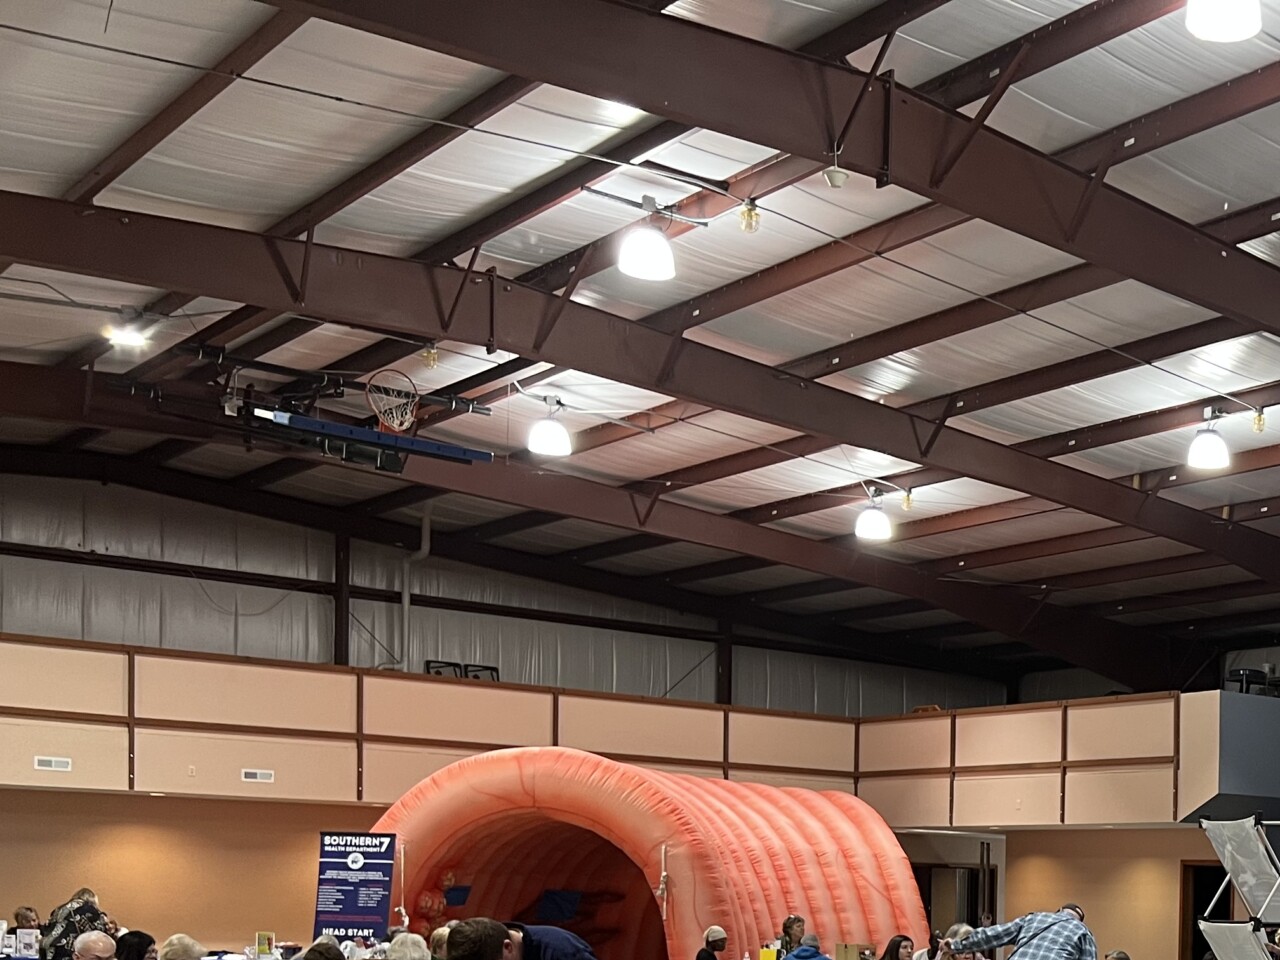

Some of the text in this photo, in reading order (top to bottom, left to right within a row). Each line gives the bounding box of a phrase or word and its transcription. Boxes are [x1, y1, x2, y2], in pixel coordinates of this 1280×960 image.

[324, 836, 391, 852] SOUTHERN 7
[322, 928, 374, 937] HEAD START
